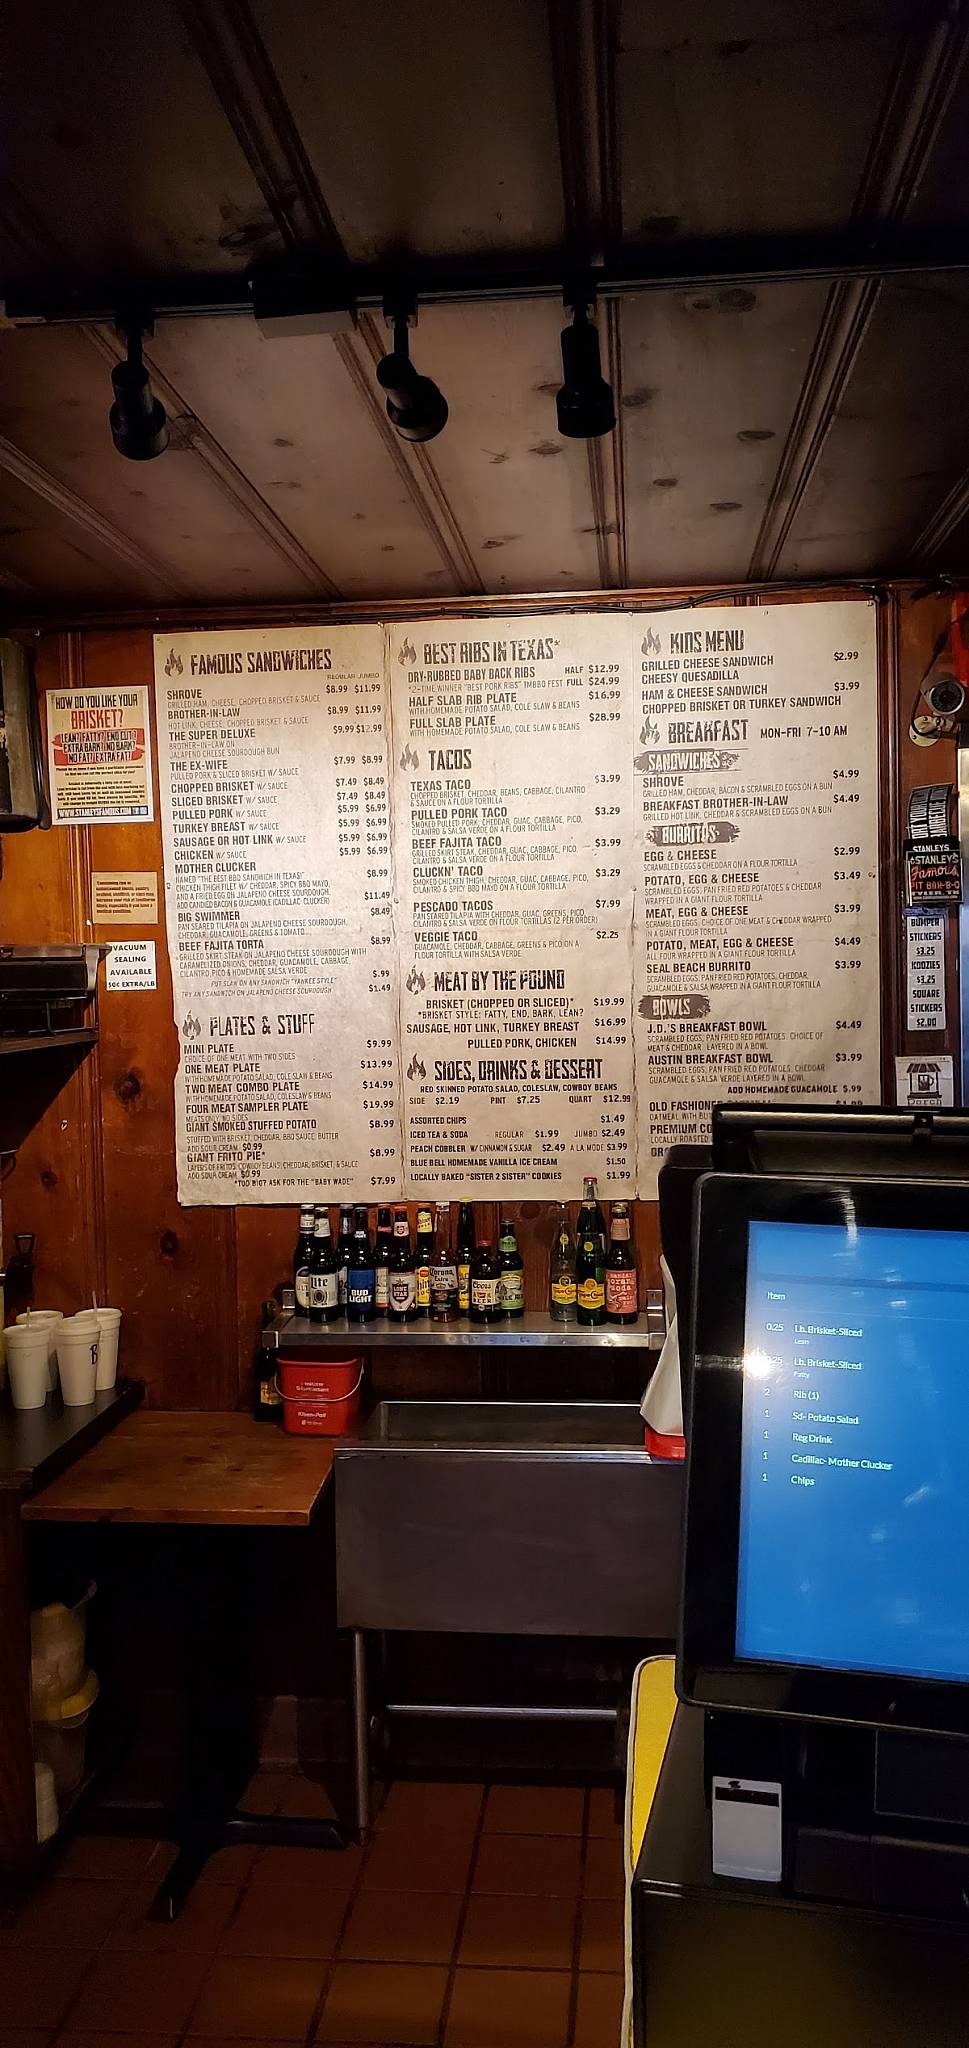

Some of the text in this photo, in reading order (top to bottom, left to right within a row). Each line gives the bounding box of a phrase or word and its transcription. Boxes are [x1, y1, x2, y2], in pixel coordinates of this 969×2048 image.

[670, 630, 744, 654] KIDS MENU
[424, 643, 456, 665] BEST
[460, 641, 490, 663] RIBS
[494, 641, 506, 662] IN
[191, 649, 332, 675] FAMOUS SANDWICHES
[565, 664, 620, 674] HALF $12.99
[588, 677, 620, 686] $24.99
[167, 684, 380, 700] SHROVE $8.99 $11.99
[56, 694, 137, 709] HOW DO YOU LIKE YOUR
[168, 701, 191, 709] GRILLED
[239, 697, 267, 706] CHOPPED
[268, 696, 293, 704] BRISKET
[295, 695, 299, 703] &
[168, 705, 381, 719] BROTHER-IN-LAW $8.99 $11.99
[409, 708, 424, 716] WITH
[465, 705, 488, 713] POTATO
[533, 702, 550, 710] SLAW
[71, 709, 123, 729] BRISKET?
[107, 731, 119, 741] END
[668, 719, 848, 744] BREAKFAST MON-FRI 7-10 AM
[64, 744, 83, 753] EXTRA
[107, 742, 115, 751] NO
[69, 753, 77, 762] NO
[96, 752, 115, 761] EXTRA
[429, 749, 472, 771] TACOS
[649, 751, 721, 770] SANDWICHES
[411, 774, 621, 791] TEXAS TACO $3.99
[662, 825, 716, 844] BURRITOS
[644, 847, 860, 862] EGG & CHEESE $2.99
[911, 918, 940, 927] BUMPER
[910, 932, 942, 941] STICKERS
[916, 947, 935, 956] $3.25
[646, 960, 862, 974] SEAL BEACH BURRITO $3.99
[912, 961, 940, 969] KOOZIES
[434, 969, 564, 991] MEAT BY THE POUND
[917, 976, 935, 984] $3.25
[913, 990, 940, 998] SQUARE
[652, 998, 690, 1016] BOWLS
[911, 1004, 942, 1013] STICKERS
[210, 1014, 315, 1036] PLATES & STUFF
[917, 1018, 936, 1027] $2.00
[435, 1058, 602, 1083] SIDES, DRINKS & DESSERT
[410, 1097, 426, 1105] SIDE
[435, 1096, 460, 1105] $2.19
[517, 1095, 540, 1104] $7.25
[569, 1095, 592, 1104] QUART
[603, 1095, 631, 1103] $12.99
[410, 1115, 625, 1125] ASSORTED CHIPS $1.49
[650, 1135, 709, 1144] LOCALLY ROASTED
[187, 1152, 214, 1162] GIANT
[218, 1152, 243, 1162] FRITO
[370, 1149, 395, 1157] $8.99
[430, 1268, 454, 1276] Corona
[311, 1277, 328, 1289] Lite
[767, 1292, 786, 1300] Item
[766, 1323, 863, 1338] 0.25 Lb. Brisket-Sliced
[794, 1358, 862, 1371] Lb. Brisket-Sliced
[794, 1391, 806, 1399] Rib
[808, 1391, 820, 1401] (1)
[792, 1412, 807, 1421] Sd-
[808, 1413, 835, 1423] Potato
[837, 1415, 859, 1425] Salad
[793, 1433, 808, 1444] Reg
[809, 1435, 832, 1444] Drink
[763, 1452, 768, 1460] 1
[828, 1458, 859, 1467] Mother
[861, 1460, 893, 1471] Clucker
[763, 1474, 815, 1486] 1 Chips
